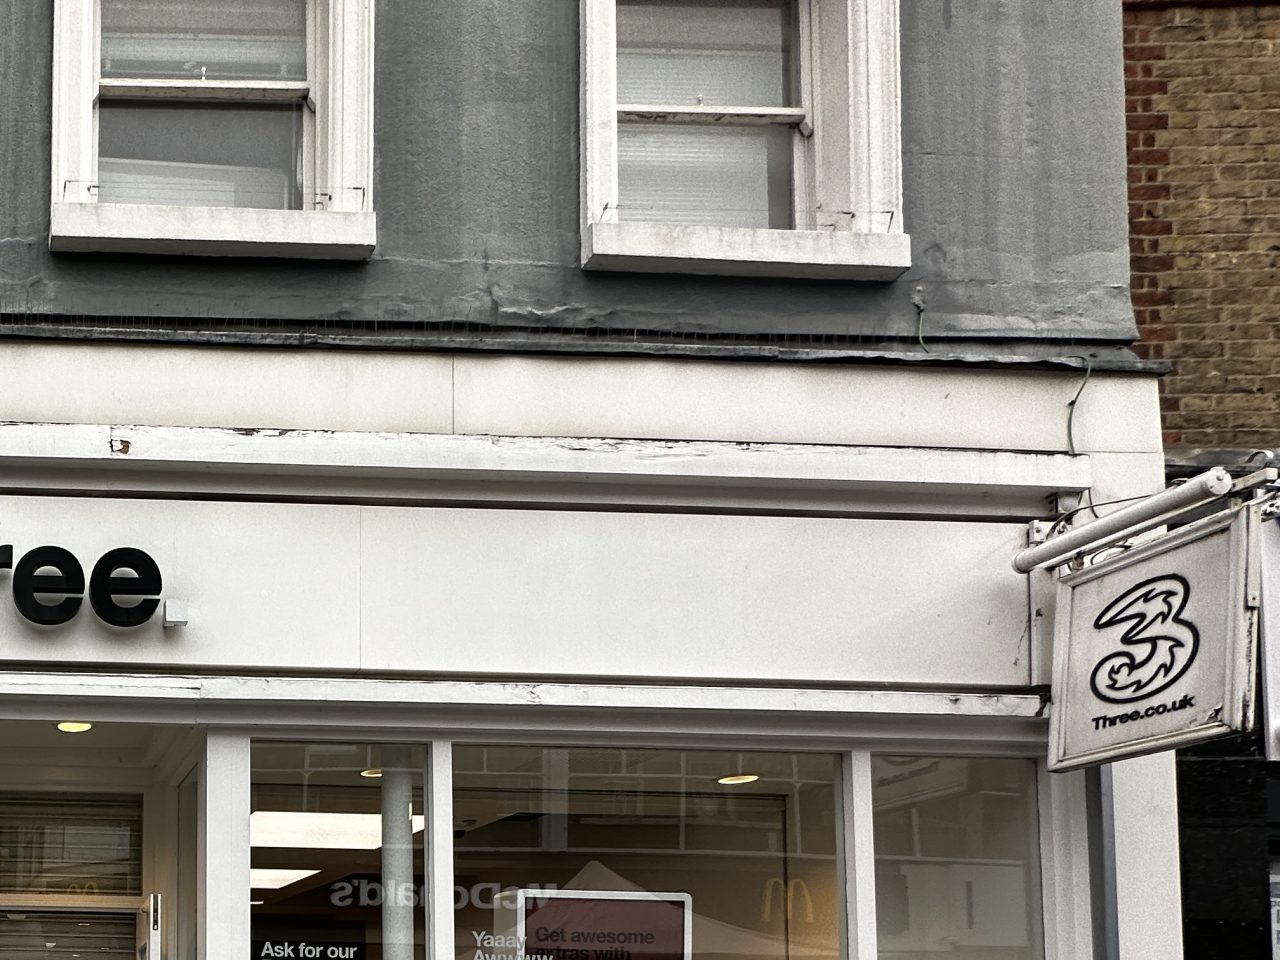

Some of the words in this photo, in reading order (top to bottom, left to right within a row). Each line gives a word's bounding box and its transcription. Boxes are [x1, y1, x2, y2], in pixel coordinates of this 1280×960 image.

[1092, 694, 1195, 730] Three.co.uk
[472, 931, 527, 951] Yaaay
[535, 927, 565, 943] Get
[570, 930, 655, 944] awesome
[261, 942, 295, 957] Ask
[298, 942, 323, 958] for
[327, 946, 357, 958] our
[535, 946, 589, 960] extras
[594, 946, 631, 960] with
